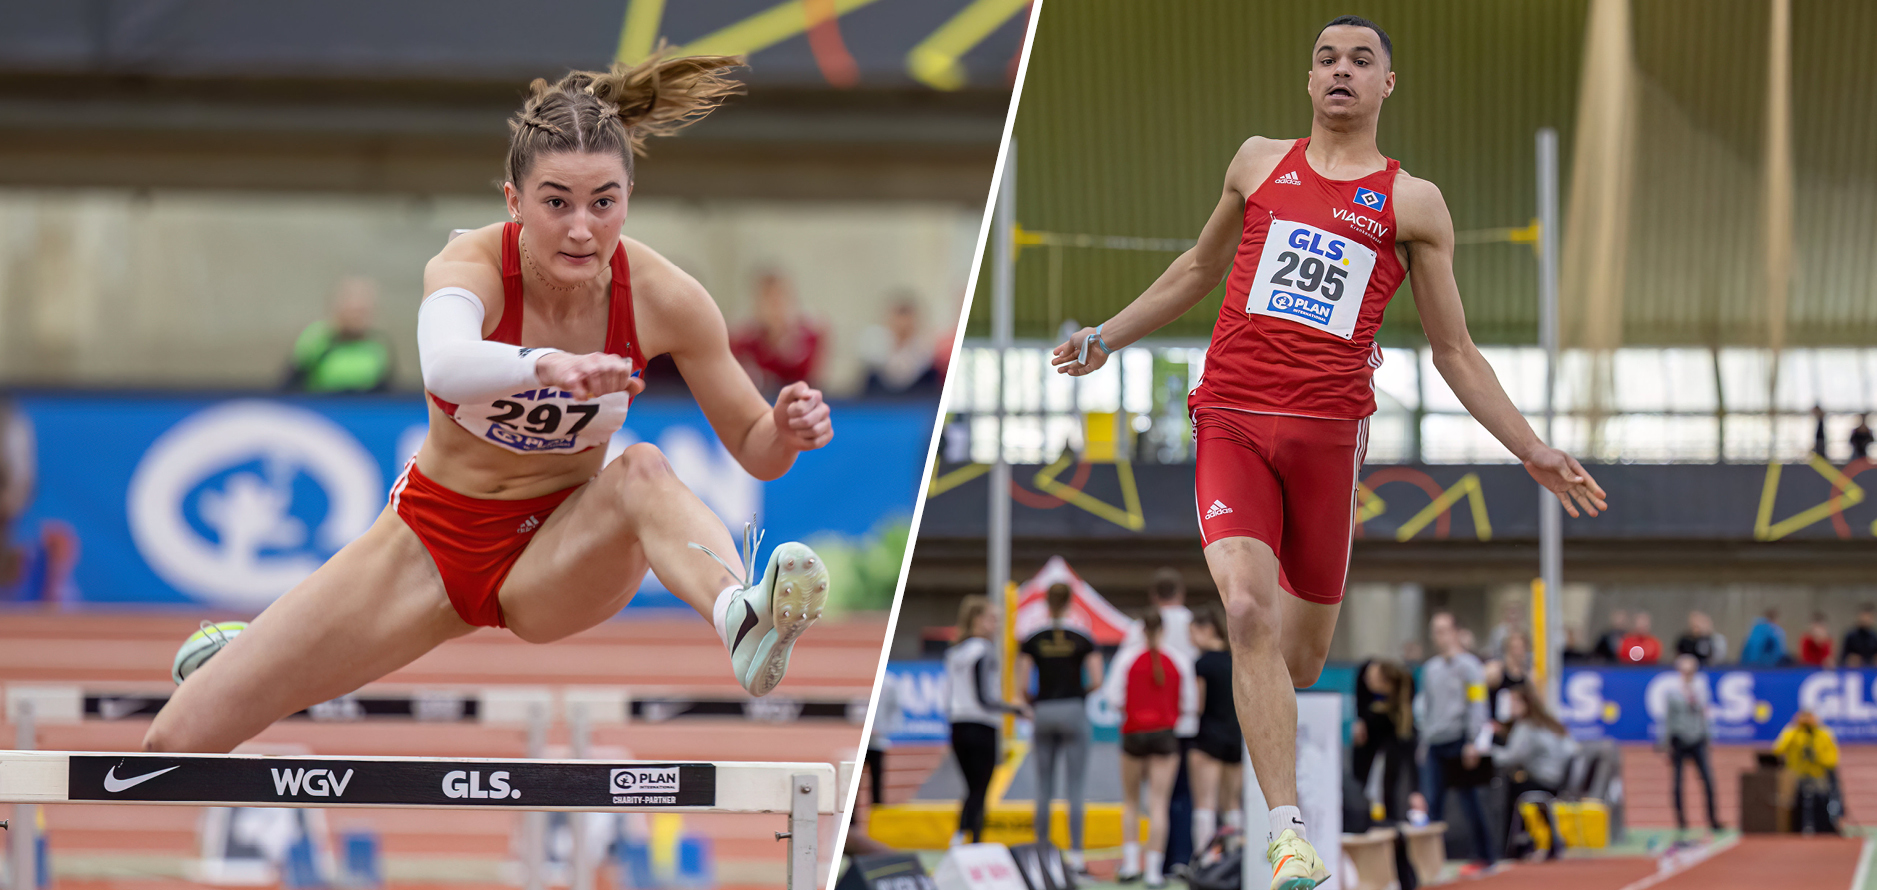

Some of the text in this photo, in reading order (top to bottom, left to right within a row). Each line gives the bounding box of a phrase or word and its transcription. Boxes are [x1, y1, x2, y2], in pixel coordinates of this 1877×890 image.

[1332, 207, 1389, 238] VIACTIV
[1288, 228, 1350, 267] GLS.
[1270, 250, 1349, 302] 295
[1293, 308, 1327, 322] INTERNATIONAL
[1294, 298, 1331, 318] PLAN
[486, 399, 600, 435] 297
[1205, 507, 1234, 520] adidas
[1799, 671, 1877, 720] GL
[271, 768, 355, 797] WGV
[441, 770, 522, 800] GLS.
[639, 773, 676, 784] PLAN
[612, 796, 677, 804] CHARITY-PARTNER
